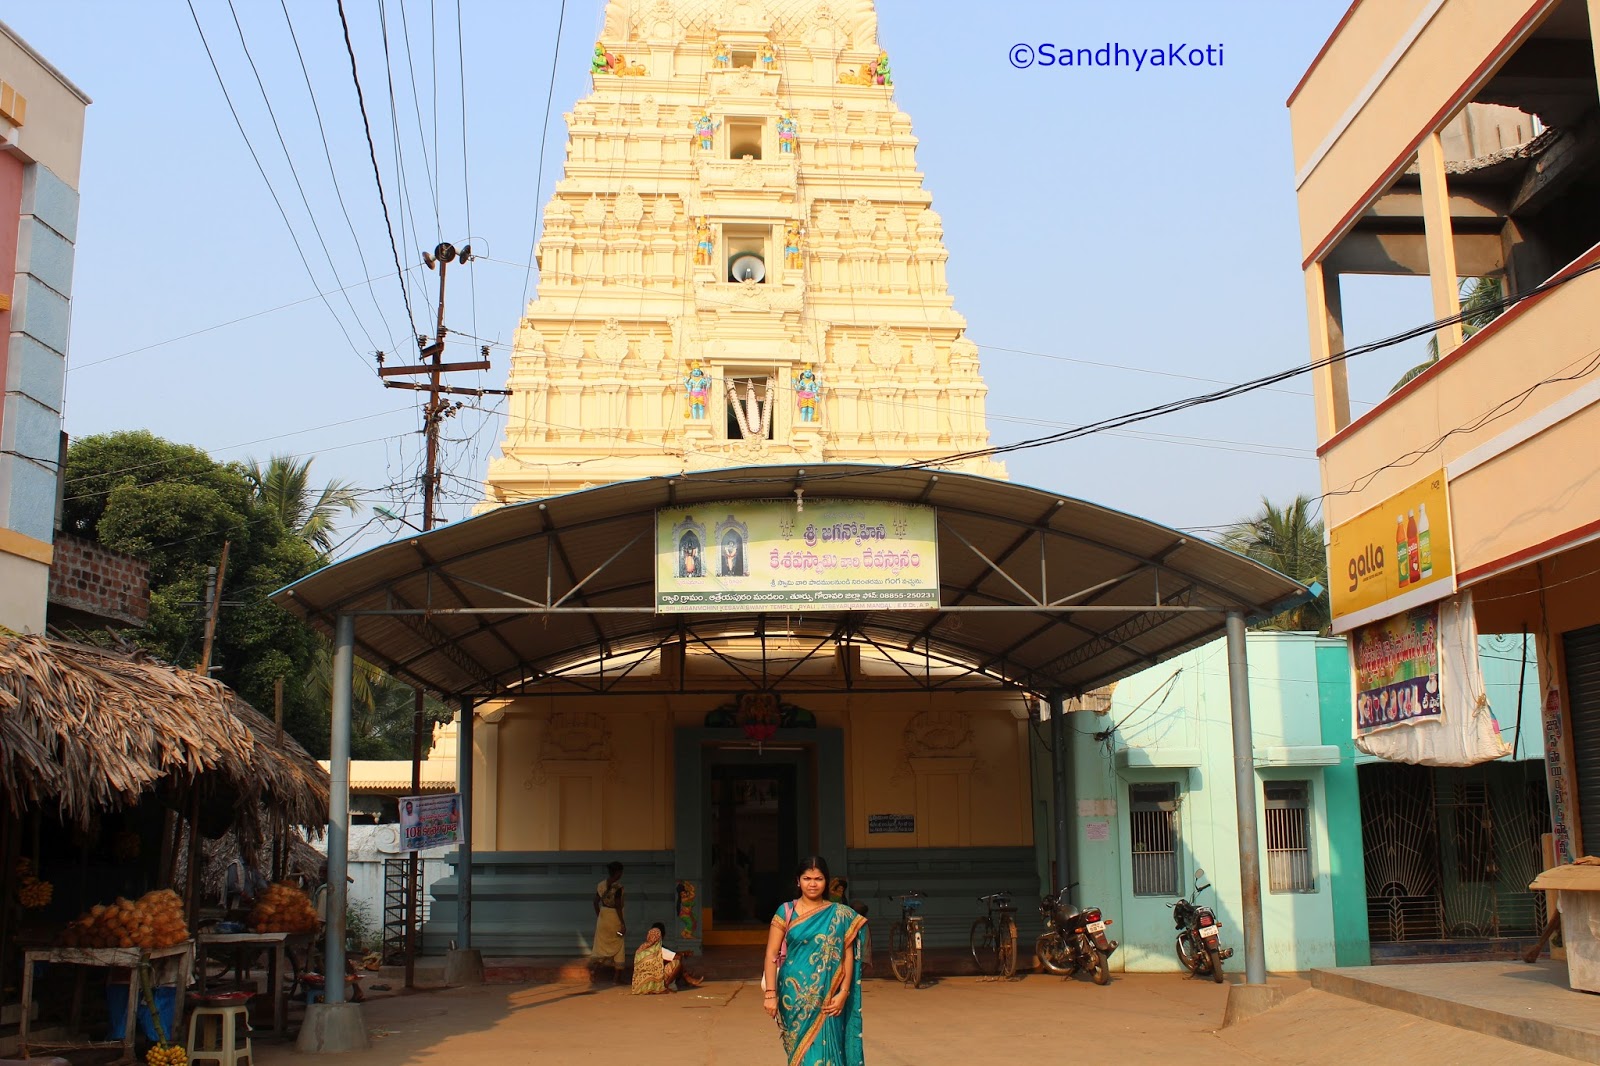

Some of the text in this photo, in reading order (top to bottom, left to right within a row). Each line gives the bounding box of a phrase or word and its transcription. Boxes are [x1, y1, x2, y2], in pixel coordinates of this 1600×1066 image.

[803, 524, 818, 547] శ్రీ
[770, 547, 920, 575] కేశవస్వామి వారి దేవస్థానం
[1348, 543, 1385, 593] galla
